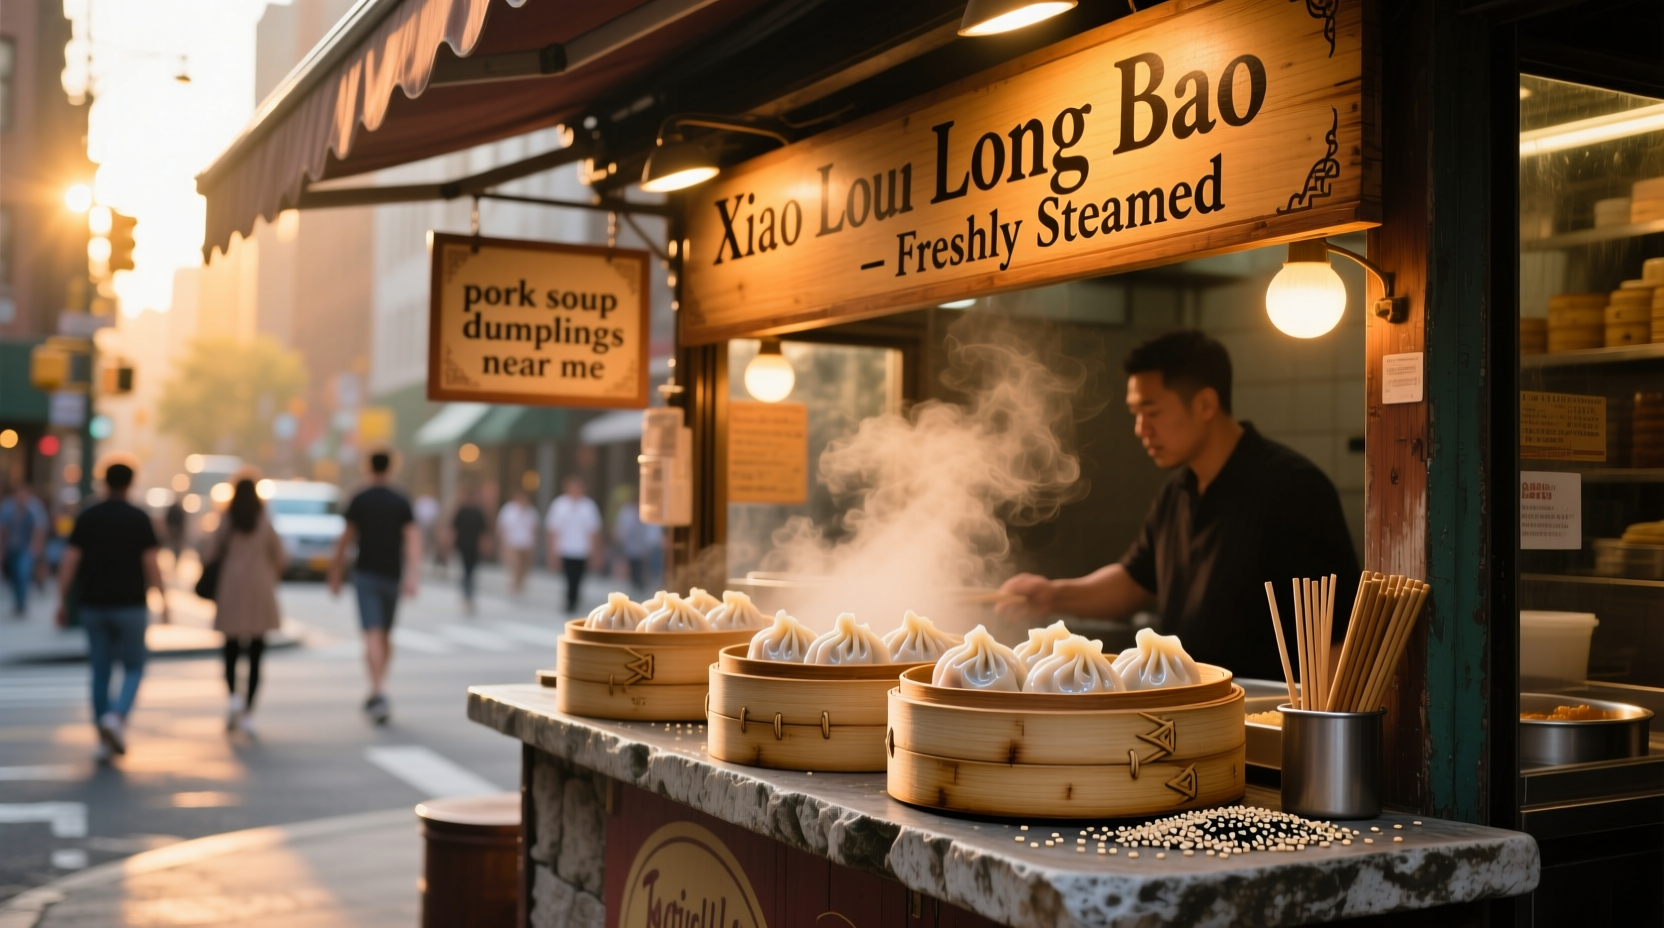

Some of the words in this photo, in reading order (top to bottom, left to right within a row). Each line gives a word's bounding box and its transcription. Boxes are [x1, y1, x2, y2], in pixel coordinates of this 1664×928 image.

[713, 192, 803, 265] Xiao
[930, 103, 1092, 204] Long
[1112, 52, 1267, 155] Bao
[895, 208, 1023, 277] Freshly
[1037, 152, 1226, 248] Steamed
[462, 279, 537, 313] pork
[545, 287, 618, 319] soup
[462, 311, 625, 354] dumplings
[482, 354, 551, 377] near
[560, 358, 605, 380] me
